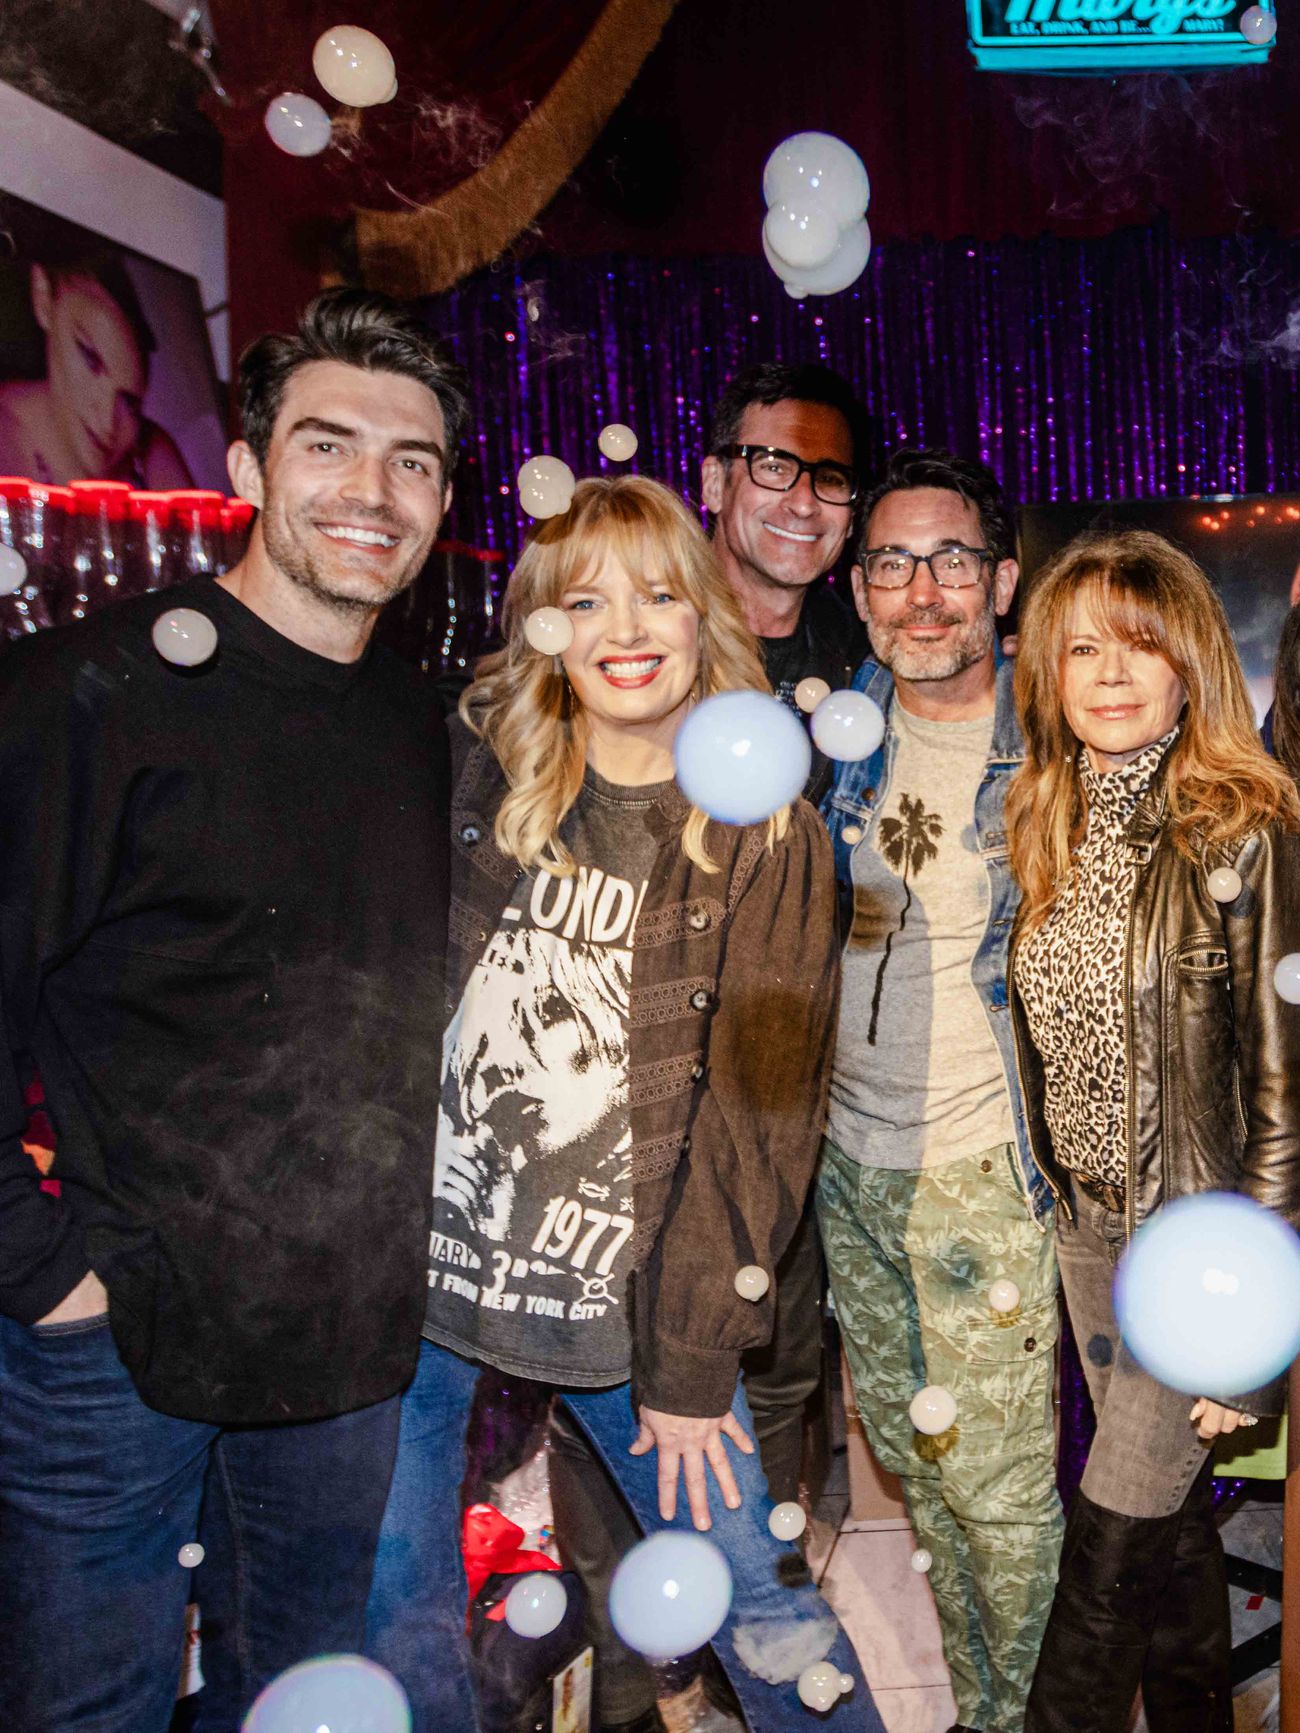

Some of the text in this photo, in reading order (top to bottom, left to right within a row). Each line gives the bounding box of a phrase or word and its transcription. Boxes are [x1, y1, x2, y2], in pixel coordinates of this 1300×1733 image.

[531, 1195, 635, 1276] 1977
[480, 1287, 521, 1312] NEW
[525, 1295, 566, 1319] YORK
[569, 1301, 607, 1320] CITY
